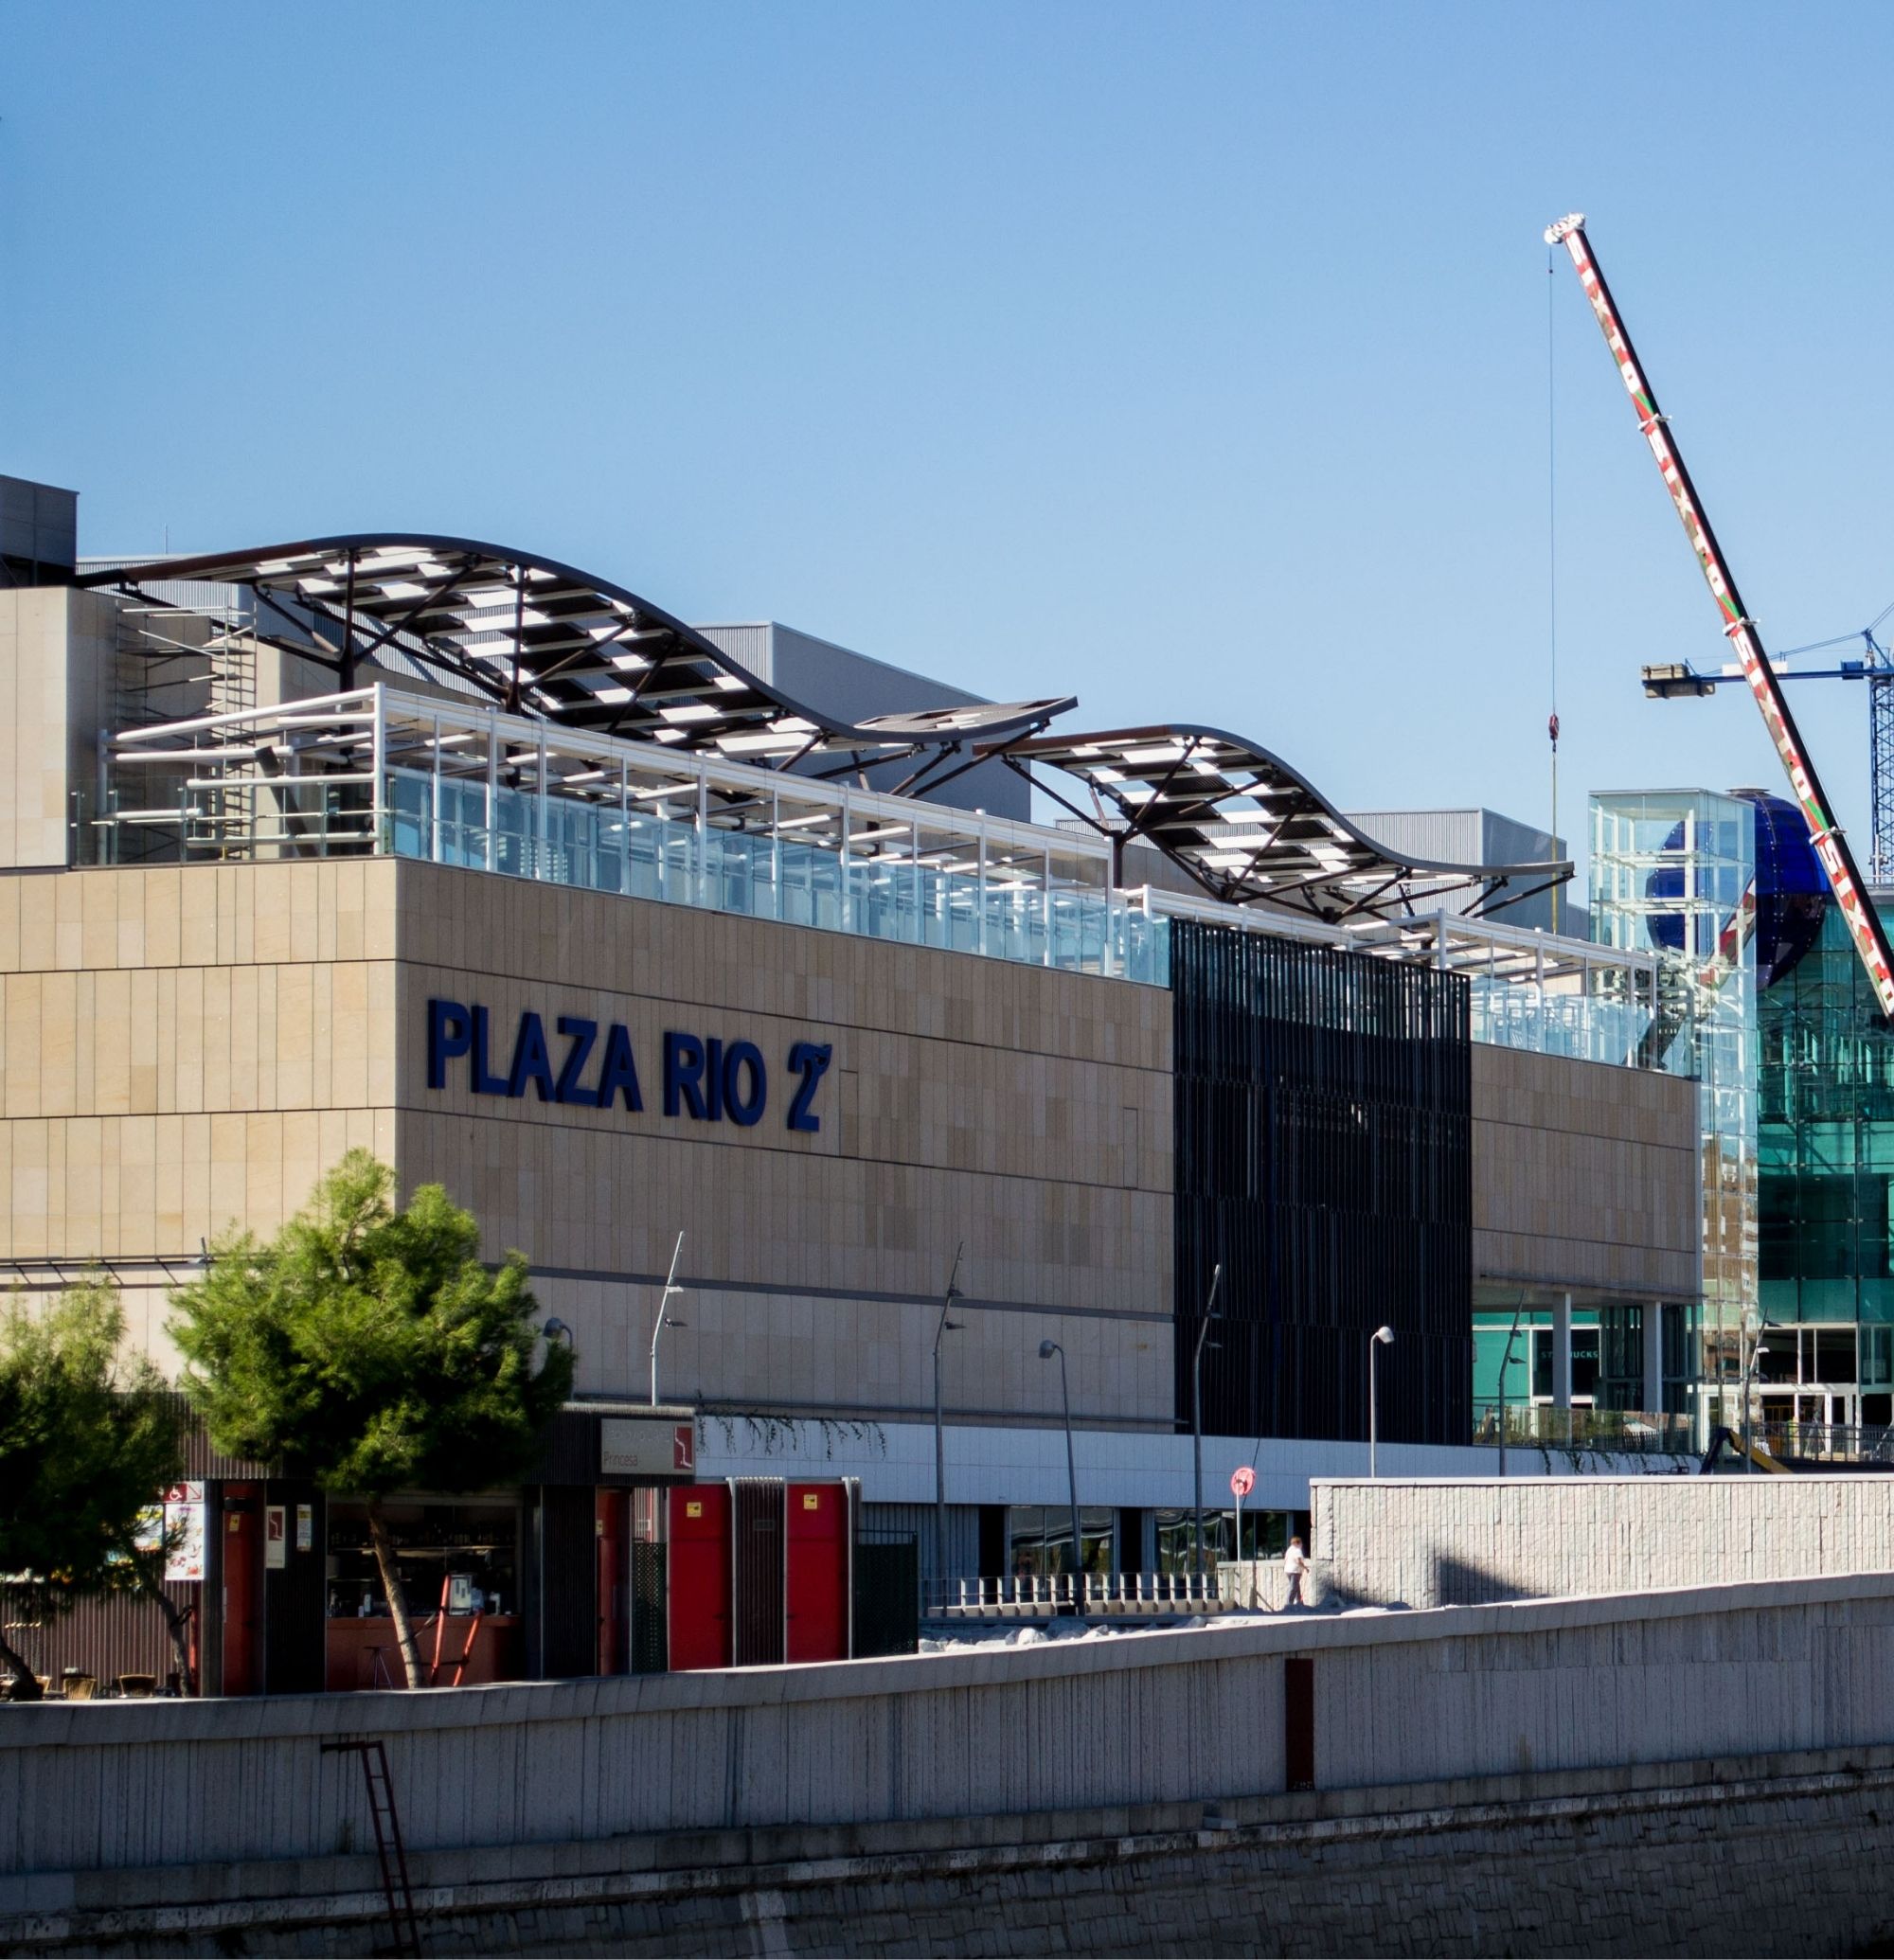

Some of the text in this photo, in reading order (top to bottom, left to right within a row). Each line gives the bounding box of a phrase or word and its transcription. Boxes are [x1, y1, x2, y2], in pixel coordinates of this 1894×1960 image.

[1565, 230, 1643, 394] SIXTO
[1648, 428, 1727, 597] SIXTO
[1732, 630, 1813, 802] SIXTO
[1819, 838, 1894, 1014] SIXTO
[427, 999, 832, 1132] PLAZA RIO 2
[1541, 1350, 1599, 1359] STUCKS
